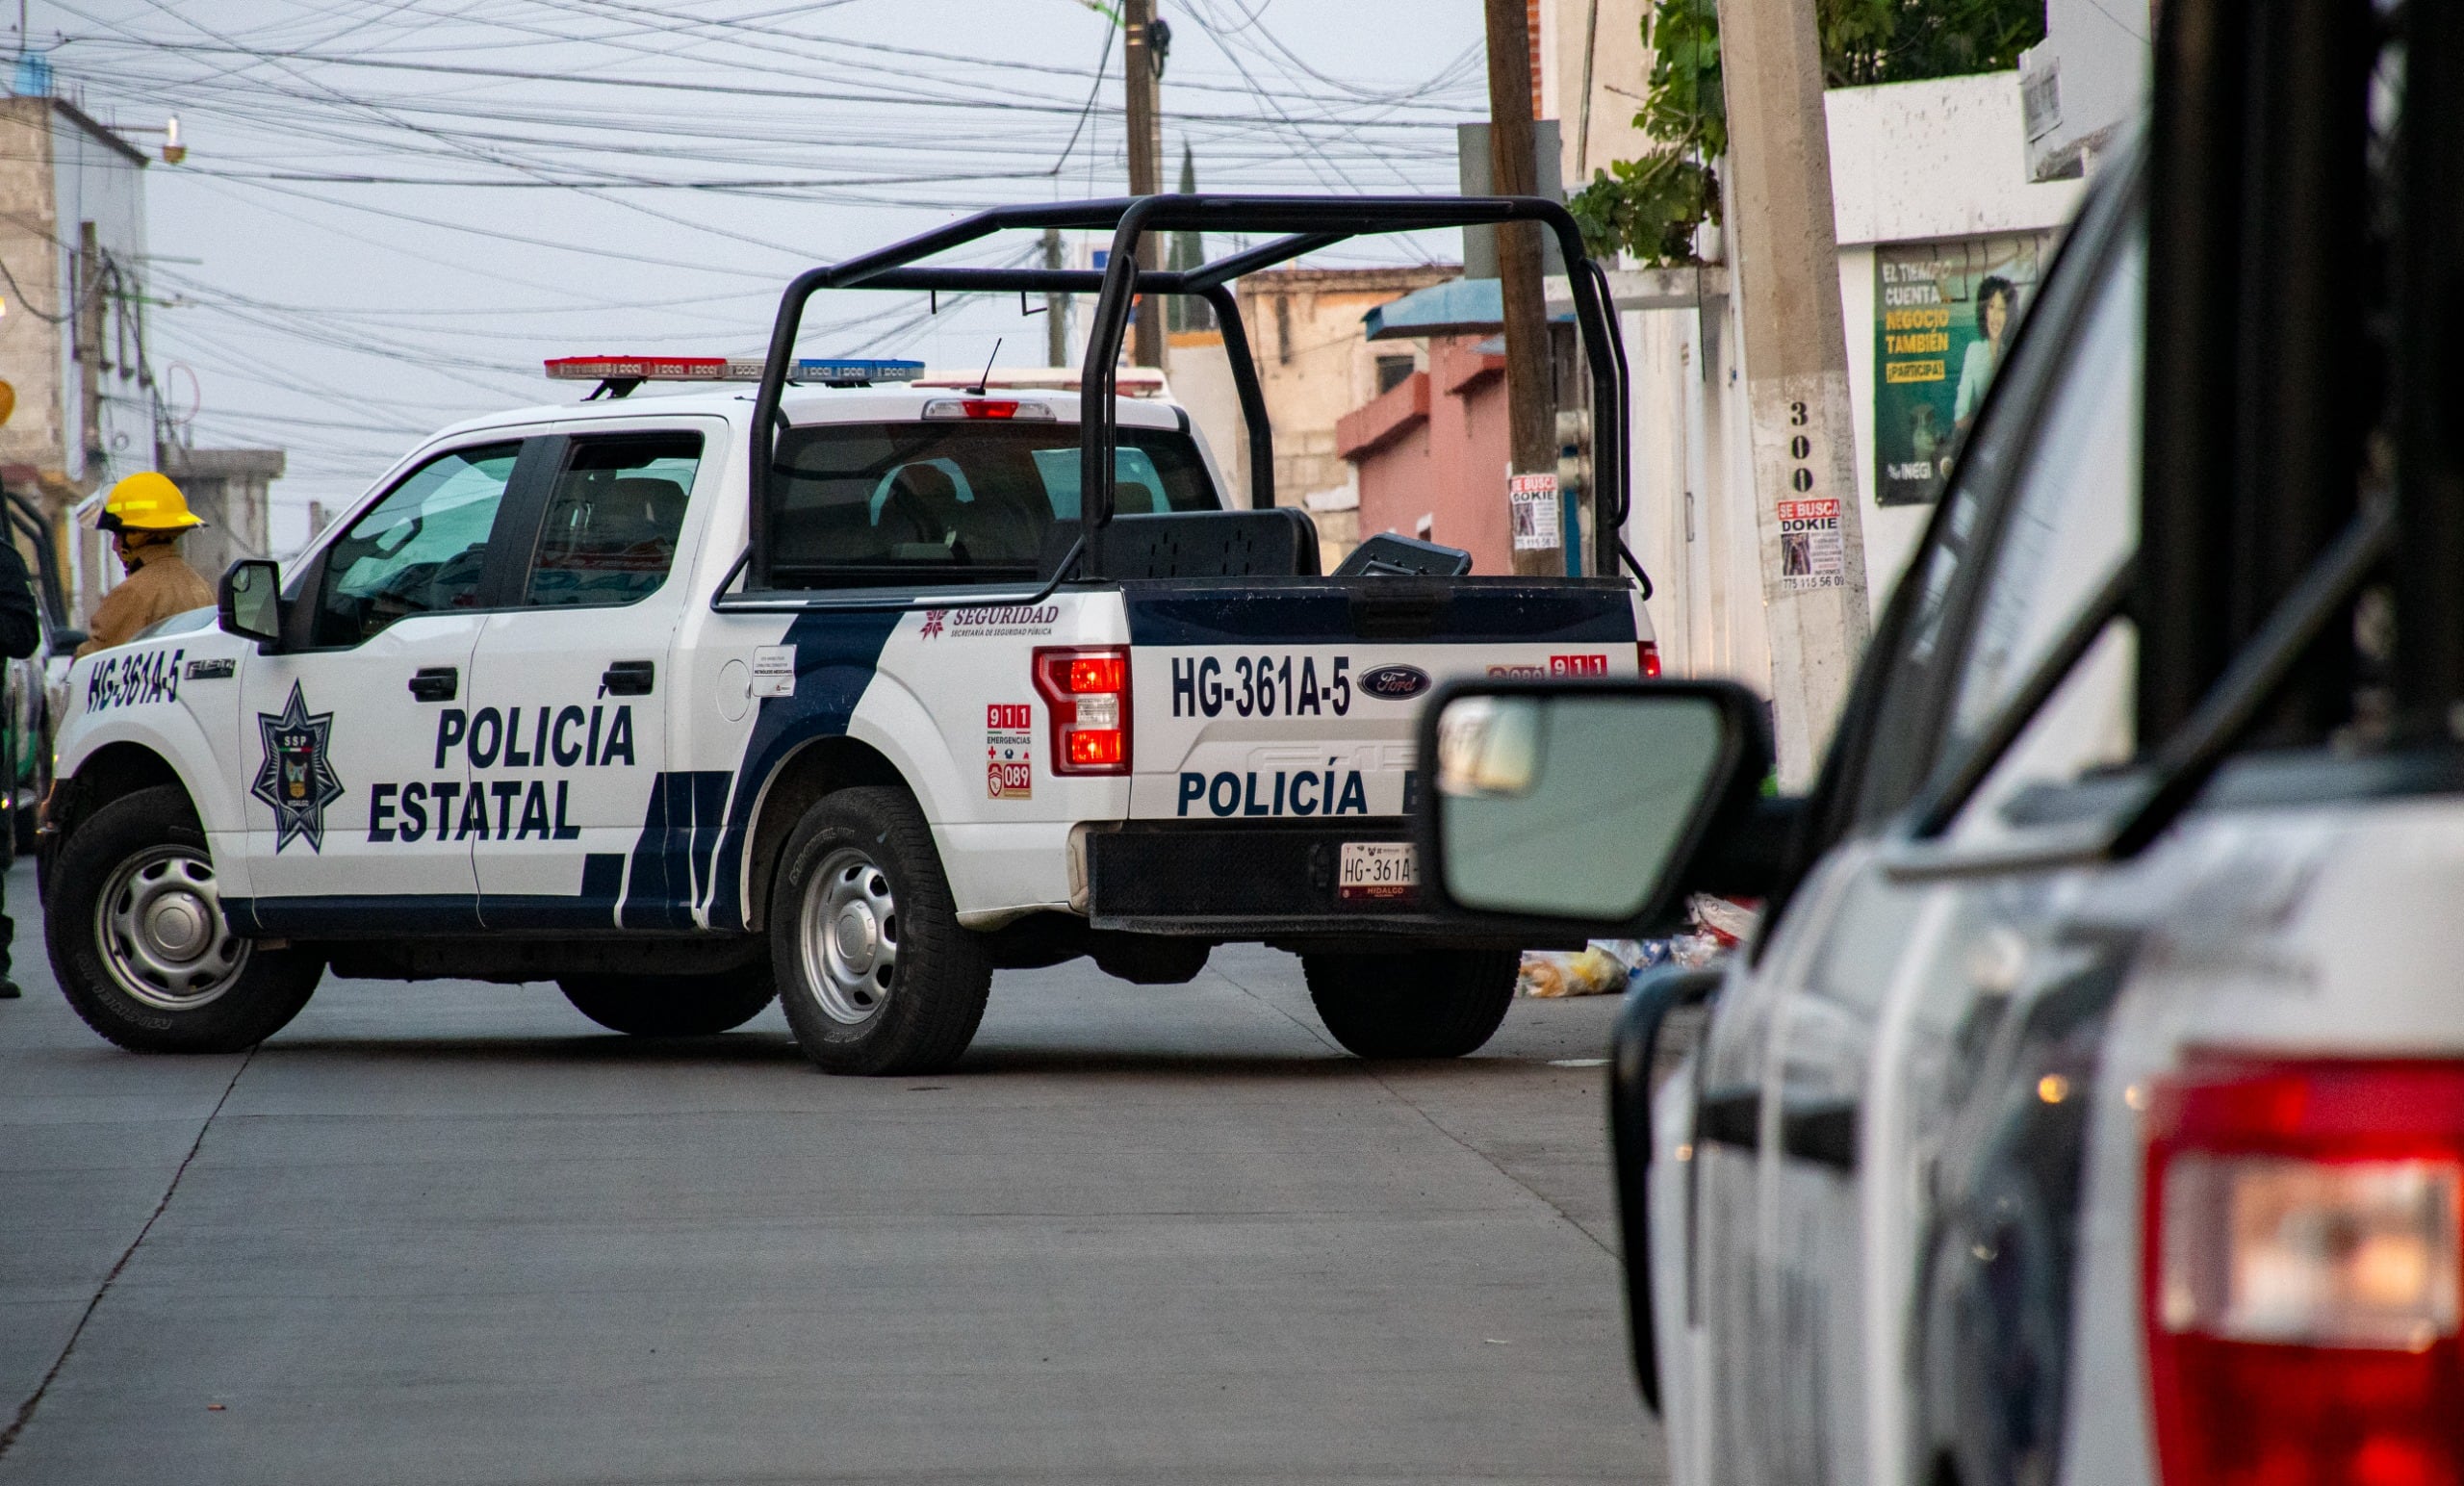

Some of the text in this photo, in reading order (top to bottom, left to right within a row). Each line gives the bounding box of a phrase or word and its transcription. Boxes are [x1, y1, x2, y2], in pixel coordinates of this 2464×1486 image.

[1883, 262, 1898, 283] EL
[1886, 285, 1941, 305] CUENTA
[1886, 309, 1949, 330] NEGOCIO
[1886, 327, 1949, 353] TAMBIÉN
[1901, 462, 1932, 479] INEGI
[1780, 500, 1840, 518] SE BUSCA
[1783, 518, 1837, 531] DOKIE
[1819, 576, 1832, 587] 56
[953, 606, 1059, 626] SEGURIDAD
[951, 628, 984, 637] SECRETARÍA
[1027, 626, 1052, 635] PÚBLICA
[87, 649, 185, 714] HG-361A-5
[1171, 655, 1350, 717] HG-361A-5
[435, 685, 635, 769] POLICÍA
[990, 707, 1028, 726] 911
[987, 736, 1031, 745] EMERGENCIAS
[1004, 765, 1029, 786] 089
[1177, 756, 1368, 816] POLICÍA
[367, 780, 581, 842] ESTATAL
[1345, 858, 1420, 883] HG-361A-
